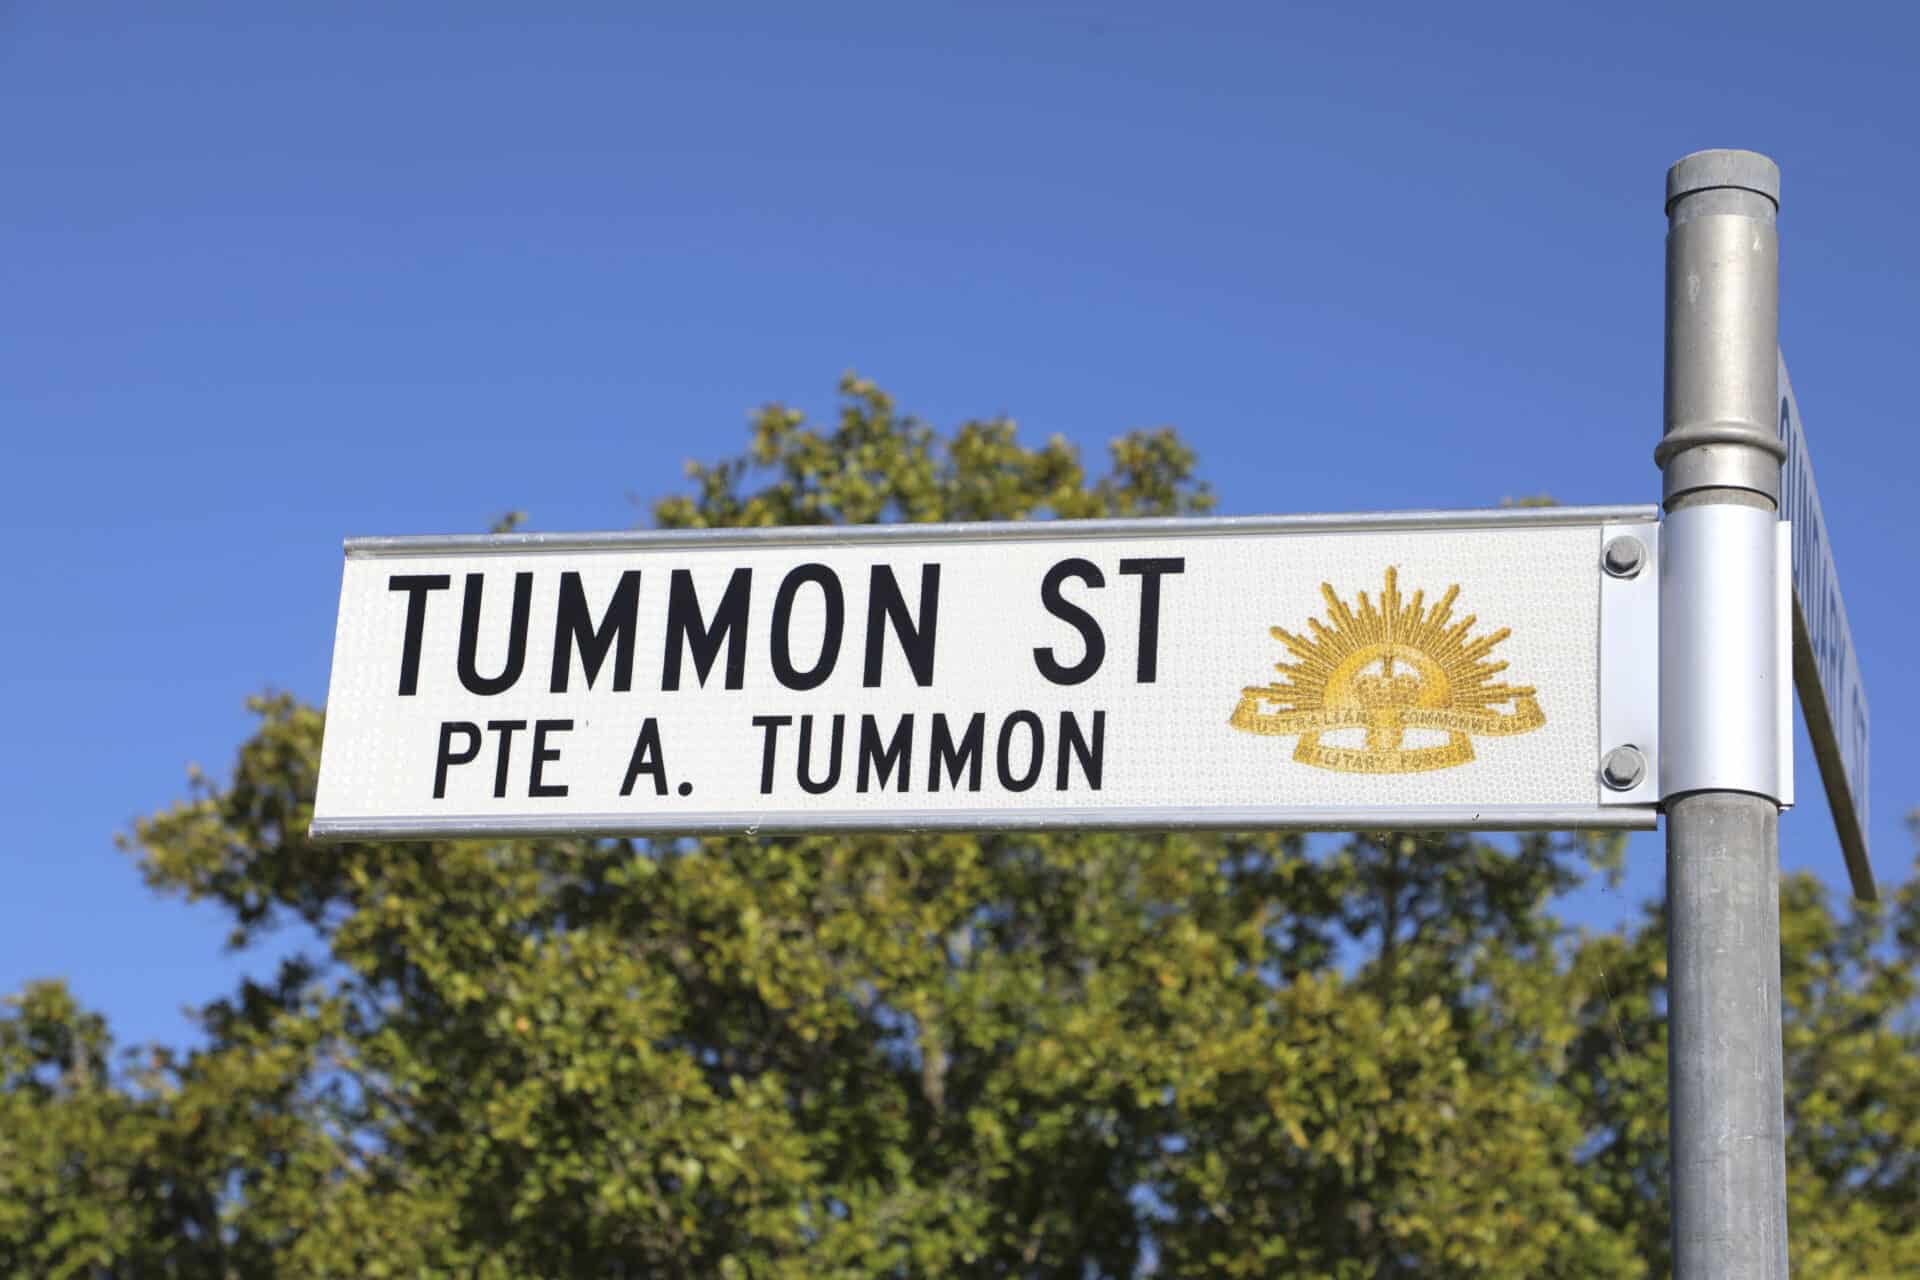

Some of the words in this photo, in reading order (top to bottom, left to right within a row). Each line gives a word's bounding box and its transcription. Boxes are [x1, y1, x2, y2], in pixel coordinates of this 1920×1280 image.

[389, 564, 941, 697] TUMMON
[1034, 558, 1185, 686] ST
[434, 719, 573, 798] PTE
[620, 718, 693, 797] A.
[753, 711, 1106, 794] TUMMON
